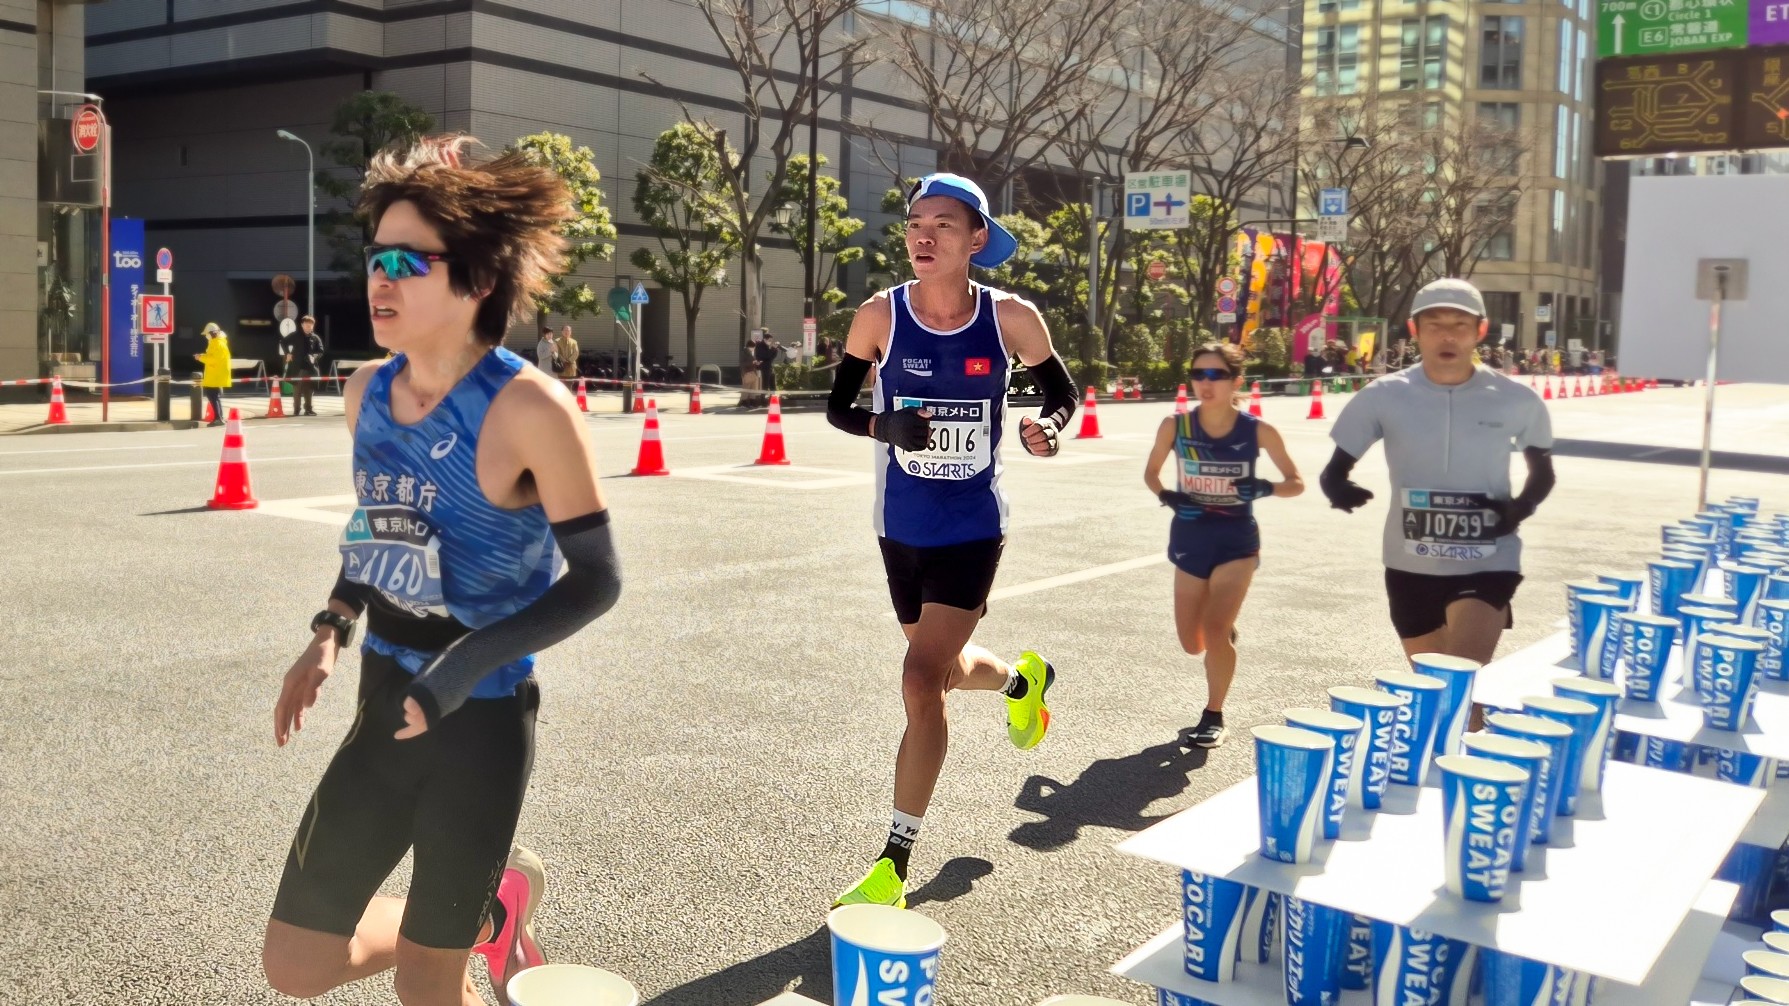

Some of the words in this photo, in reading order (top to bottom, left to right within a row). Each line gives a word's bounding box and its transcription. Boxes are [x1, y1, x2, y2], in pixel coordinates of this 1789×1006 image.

[1601, 2, 1636, 12] 700m
[1668, 11, 1700, 21] Circle
[1705, 9, 1711, 18] 1
[1670, 35, 1707, 47] JOBAN
[1711, 32, 1733, 43] EXP
[1131, 194, 1146, 216] P
[113, 250, 142, 268] too
[912, 452, 931, 460] TOKYO
[355, 469, 438, 513] 東京都庁
[1183, 476, 1236, 494] MORITA
[373, 517, 429, 537] 東京メトロ
[1406, 511, 1417, 524] A
[1424, 512, 1482, 538] 10799
[359, 549, 424, 596] 4160
[1631, 625, 1655, 699] POCARI
[1711, 649, 1735, 728] POCARI
[1366, 709, 1394, 795] SWEAT
[1390, 688, 1413, 782] POCARI
[1328, 733, 1355, 825] SWEAT
[1466, 782, 1498, 888] SWEAT
[1488, 785, 1521, 899] POCARI
